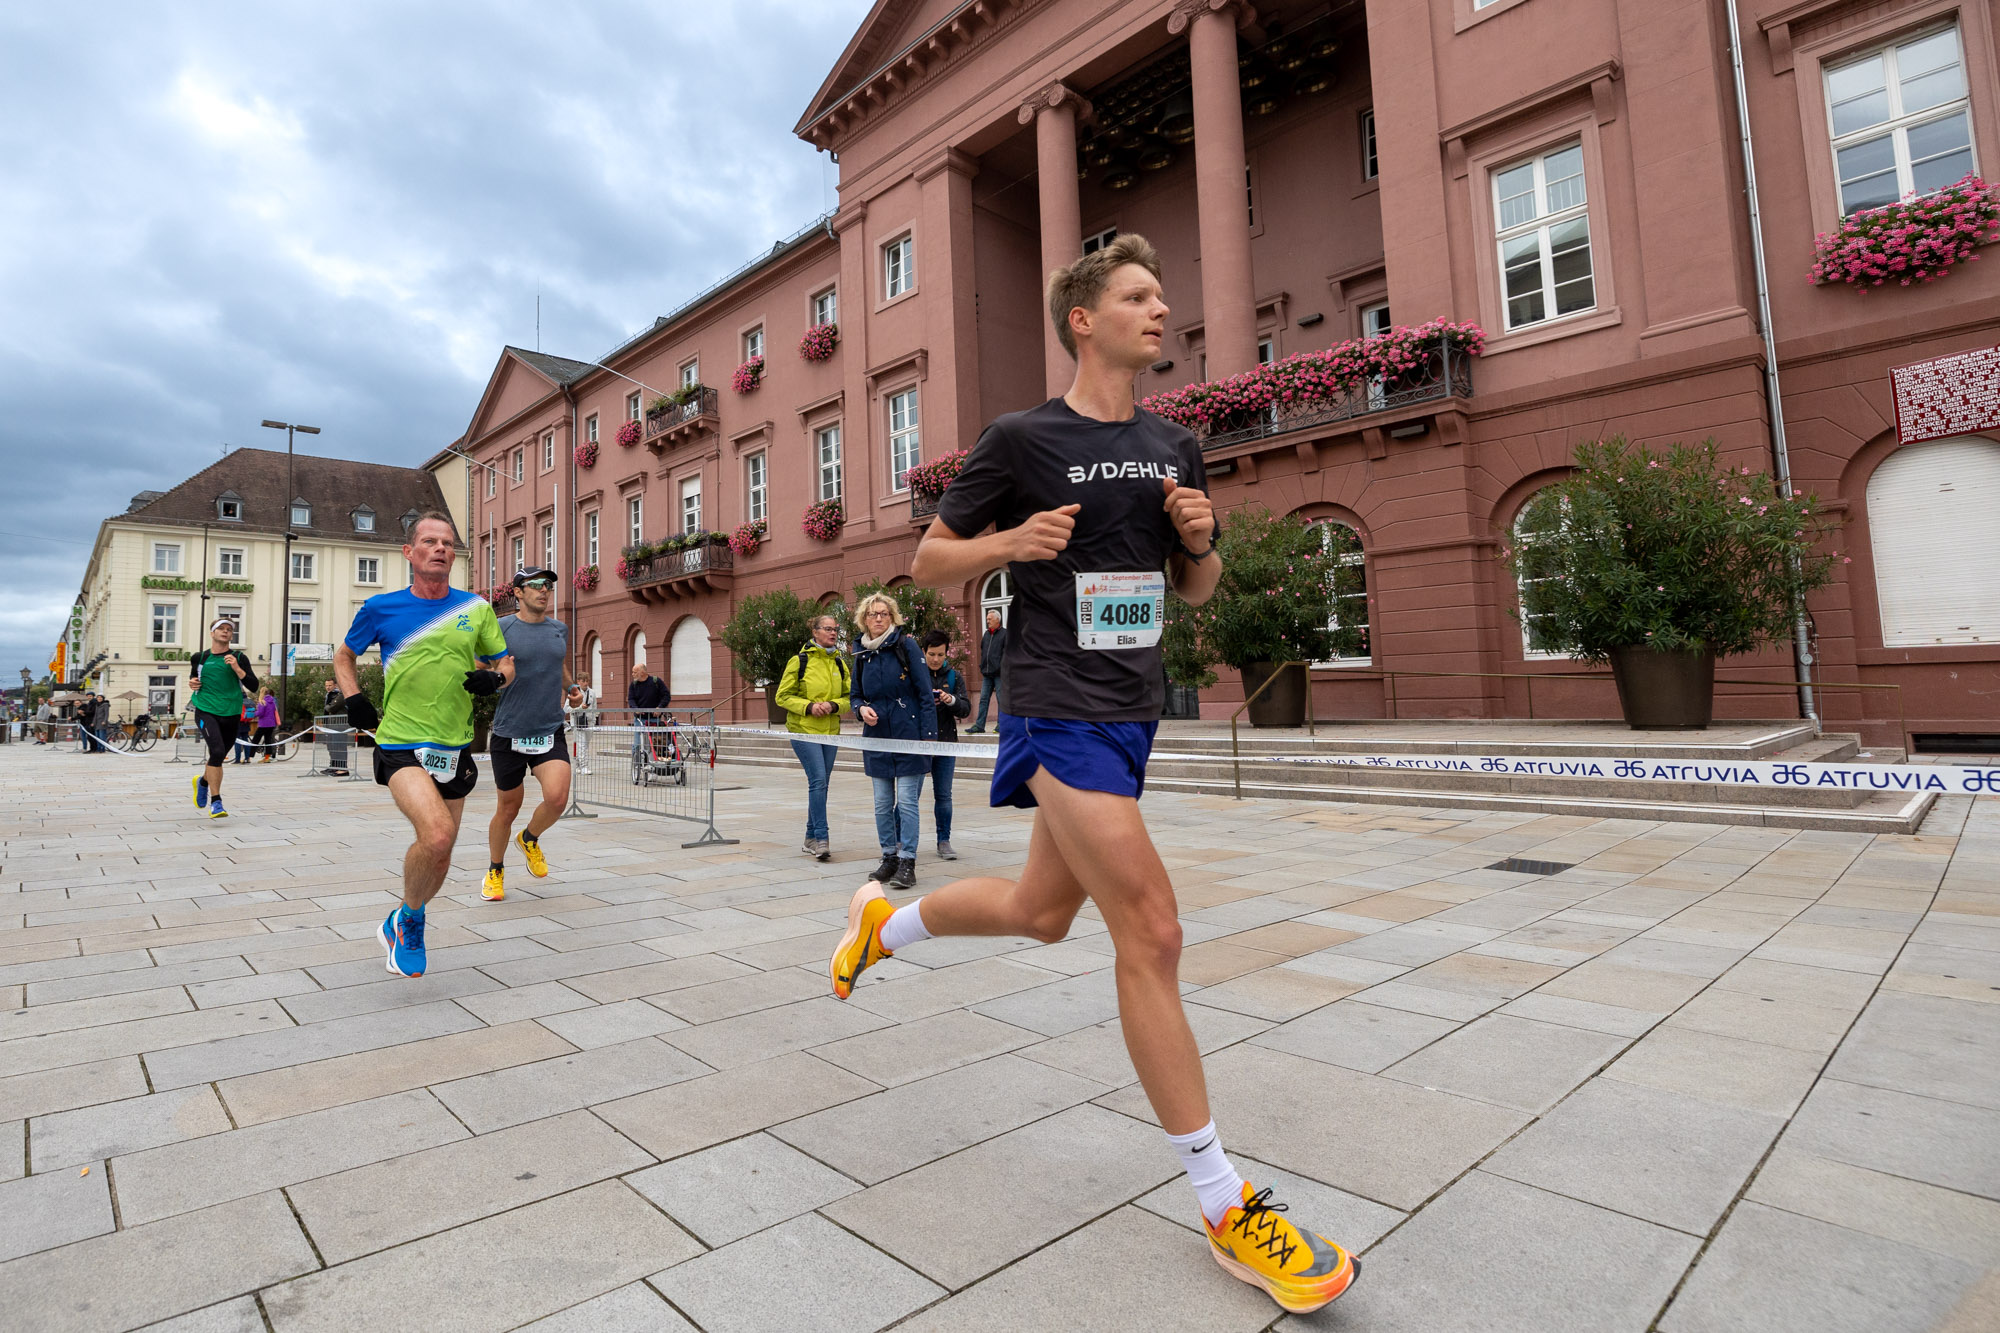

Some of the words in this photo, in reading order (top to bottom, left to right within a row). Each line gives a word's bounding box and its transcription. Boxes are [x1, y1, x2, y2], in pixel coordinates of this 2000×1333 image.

[1961, 355, 1984, 364] MEHR
[1894, 361, 1932, 373] POLITIKER
[1923, 374, 1943, 382] WIRD
[1964, 363, 1995, 373] POLITIK
[1943, 373, 1969, 383] RECHT
[1972, 369, 1990, 377] UND
[1910, 381, 1960, 395] DEMOKRATIE
[1964, 375, 1983, 383] SIND
[1953, 386, 1983, 396] MEDIEN
[1917, 415, 1940, 423] KEINE
[1967, 411, 1992, 419] NICHT
[1949, 417, 1988, 428] BEGREIFT
[1916, 424, 1977, 439] GESELLSCHAFT
[207, 578, 254, 593] Pilsner
[1100, 603, 1151, 625] 4088
[72, 606, 83, 664] HOTEL
[1091, 637, 1096, 645] A
[1117, 635, 1137, 645] Elias
[521, 736, 544, 745] 4148
[425, 753, 447, 769] 2025
[1395, 759, 1473, 771] ATRUVIA
[1513, 761, 1604, 777] ATRUVIA
[1651, 765, 1760, 783] ATRUVIA
[1817, 770, 1947, 791] ATRUVIA
